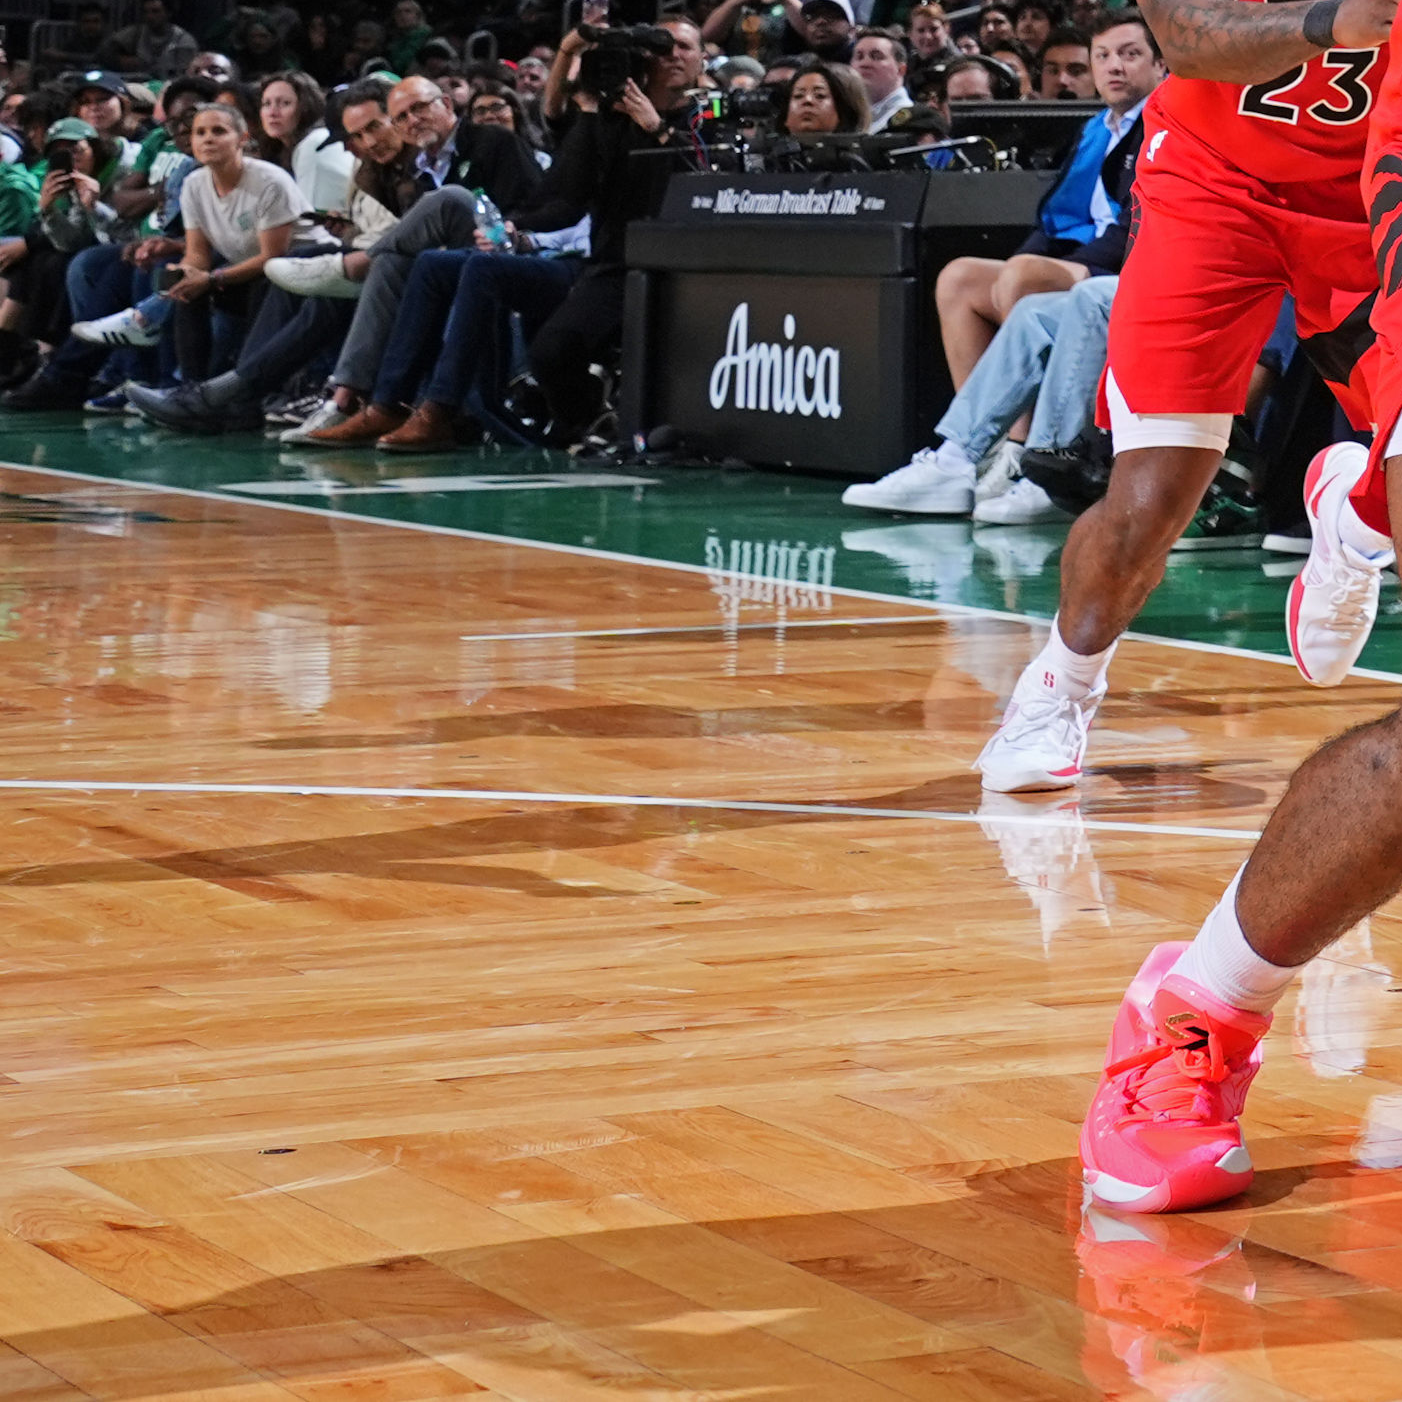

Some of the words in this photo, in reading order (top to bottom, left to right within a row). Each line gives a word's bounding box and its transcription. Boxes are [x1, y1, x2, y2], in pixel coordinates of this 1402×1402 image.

[1237, 46, 1380, 126] 23
[778, 187, 832, 215] Broadcast
[829, 187, 862, 215] Table
[709, 302, 842, 420] Amica
